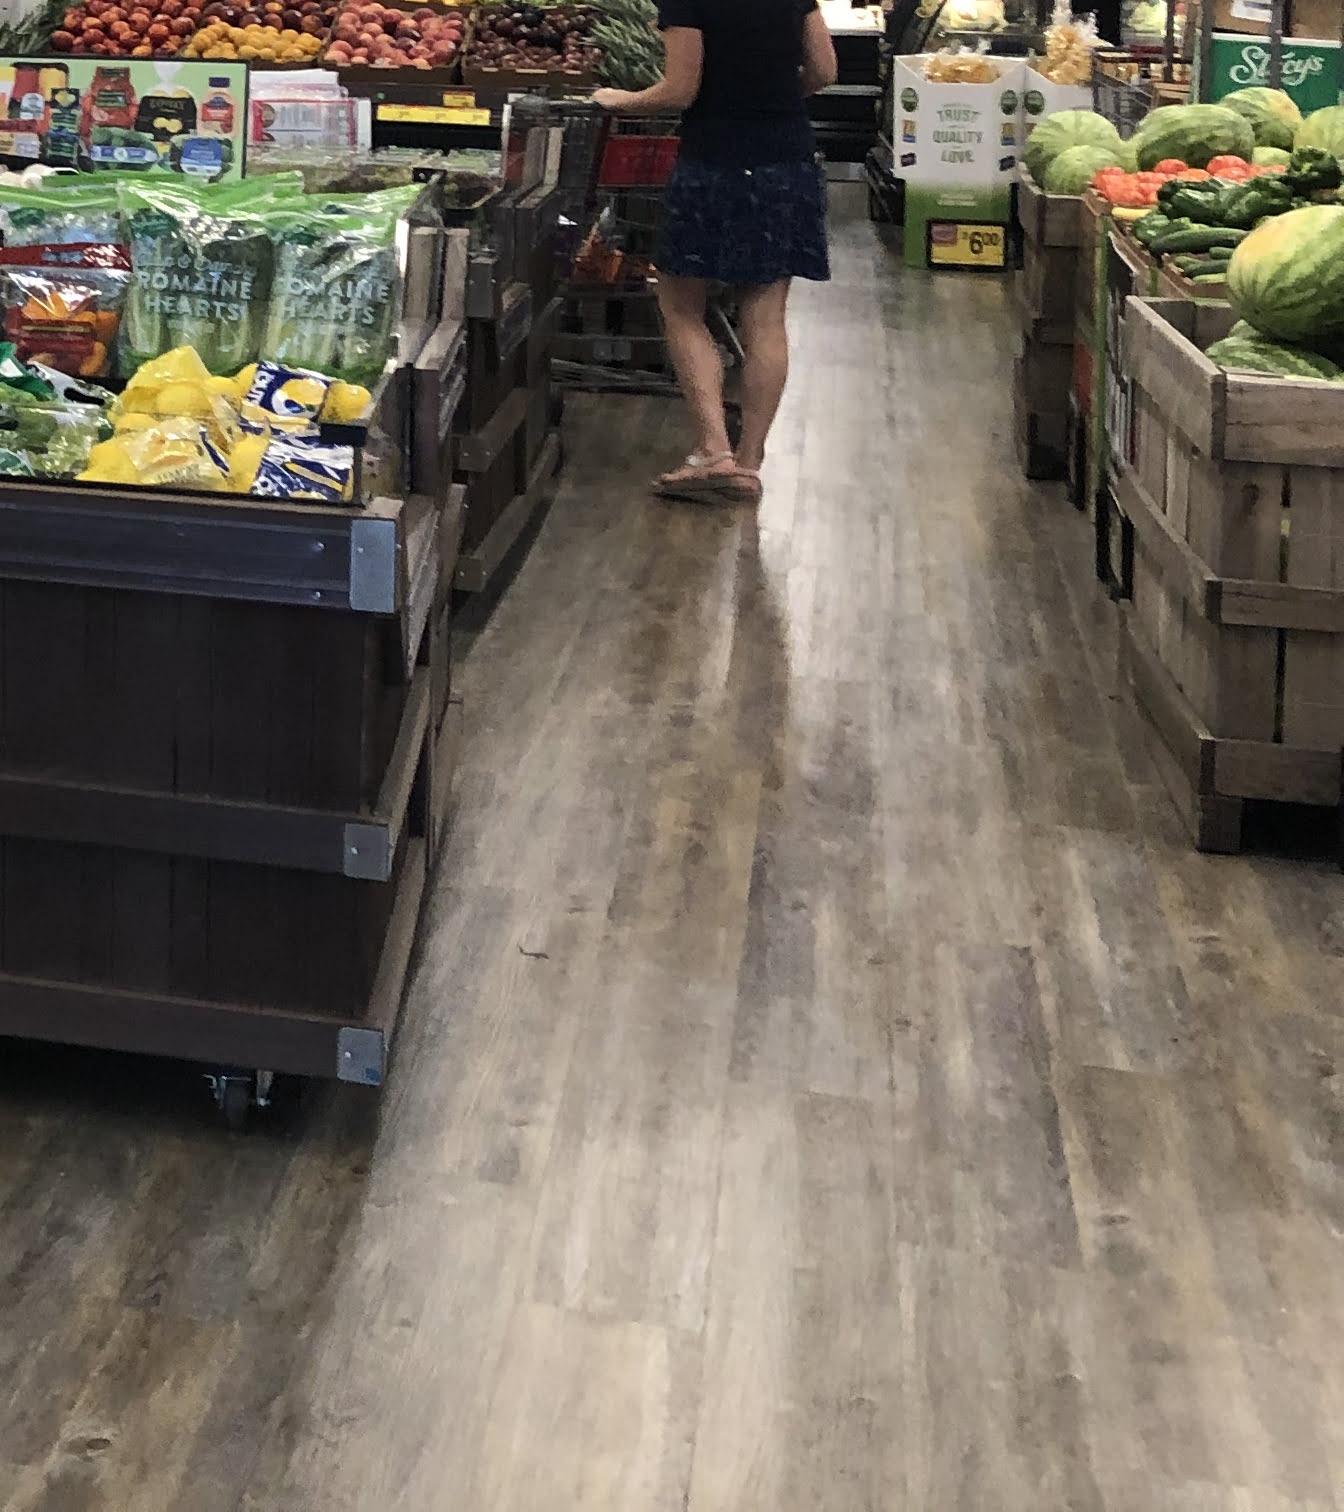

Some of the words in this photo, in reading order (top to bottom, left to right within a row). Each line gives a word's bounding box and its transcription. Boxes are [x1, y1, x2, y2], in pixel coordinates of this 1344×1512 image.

[136, 271, 253, 300] ROMAINE
[145, 294, 241, 321] HEARTS
[283, 299, 374, 325] HEARTS
